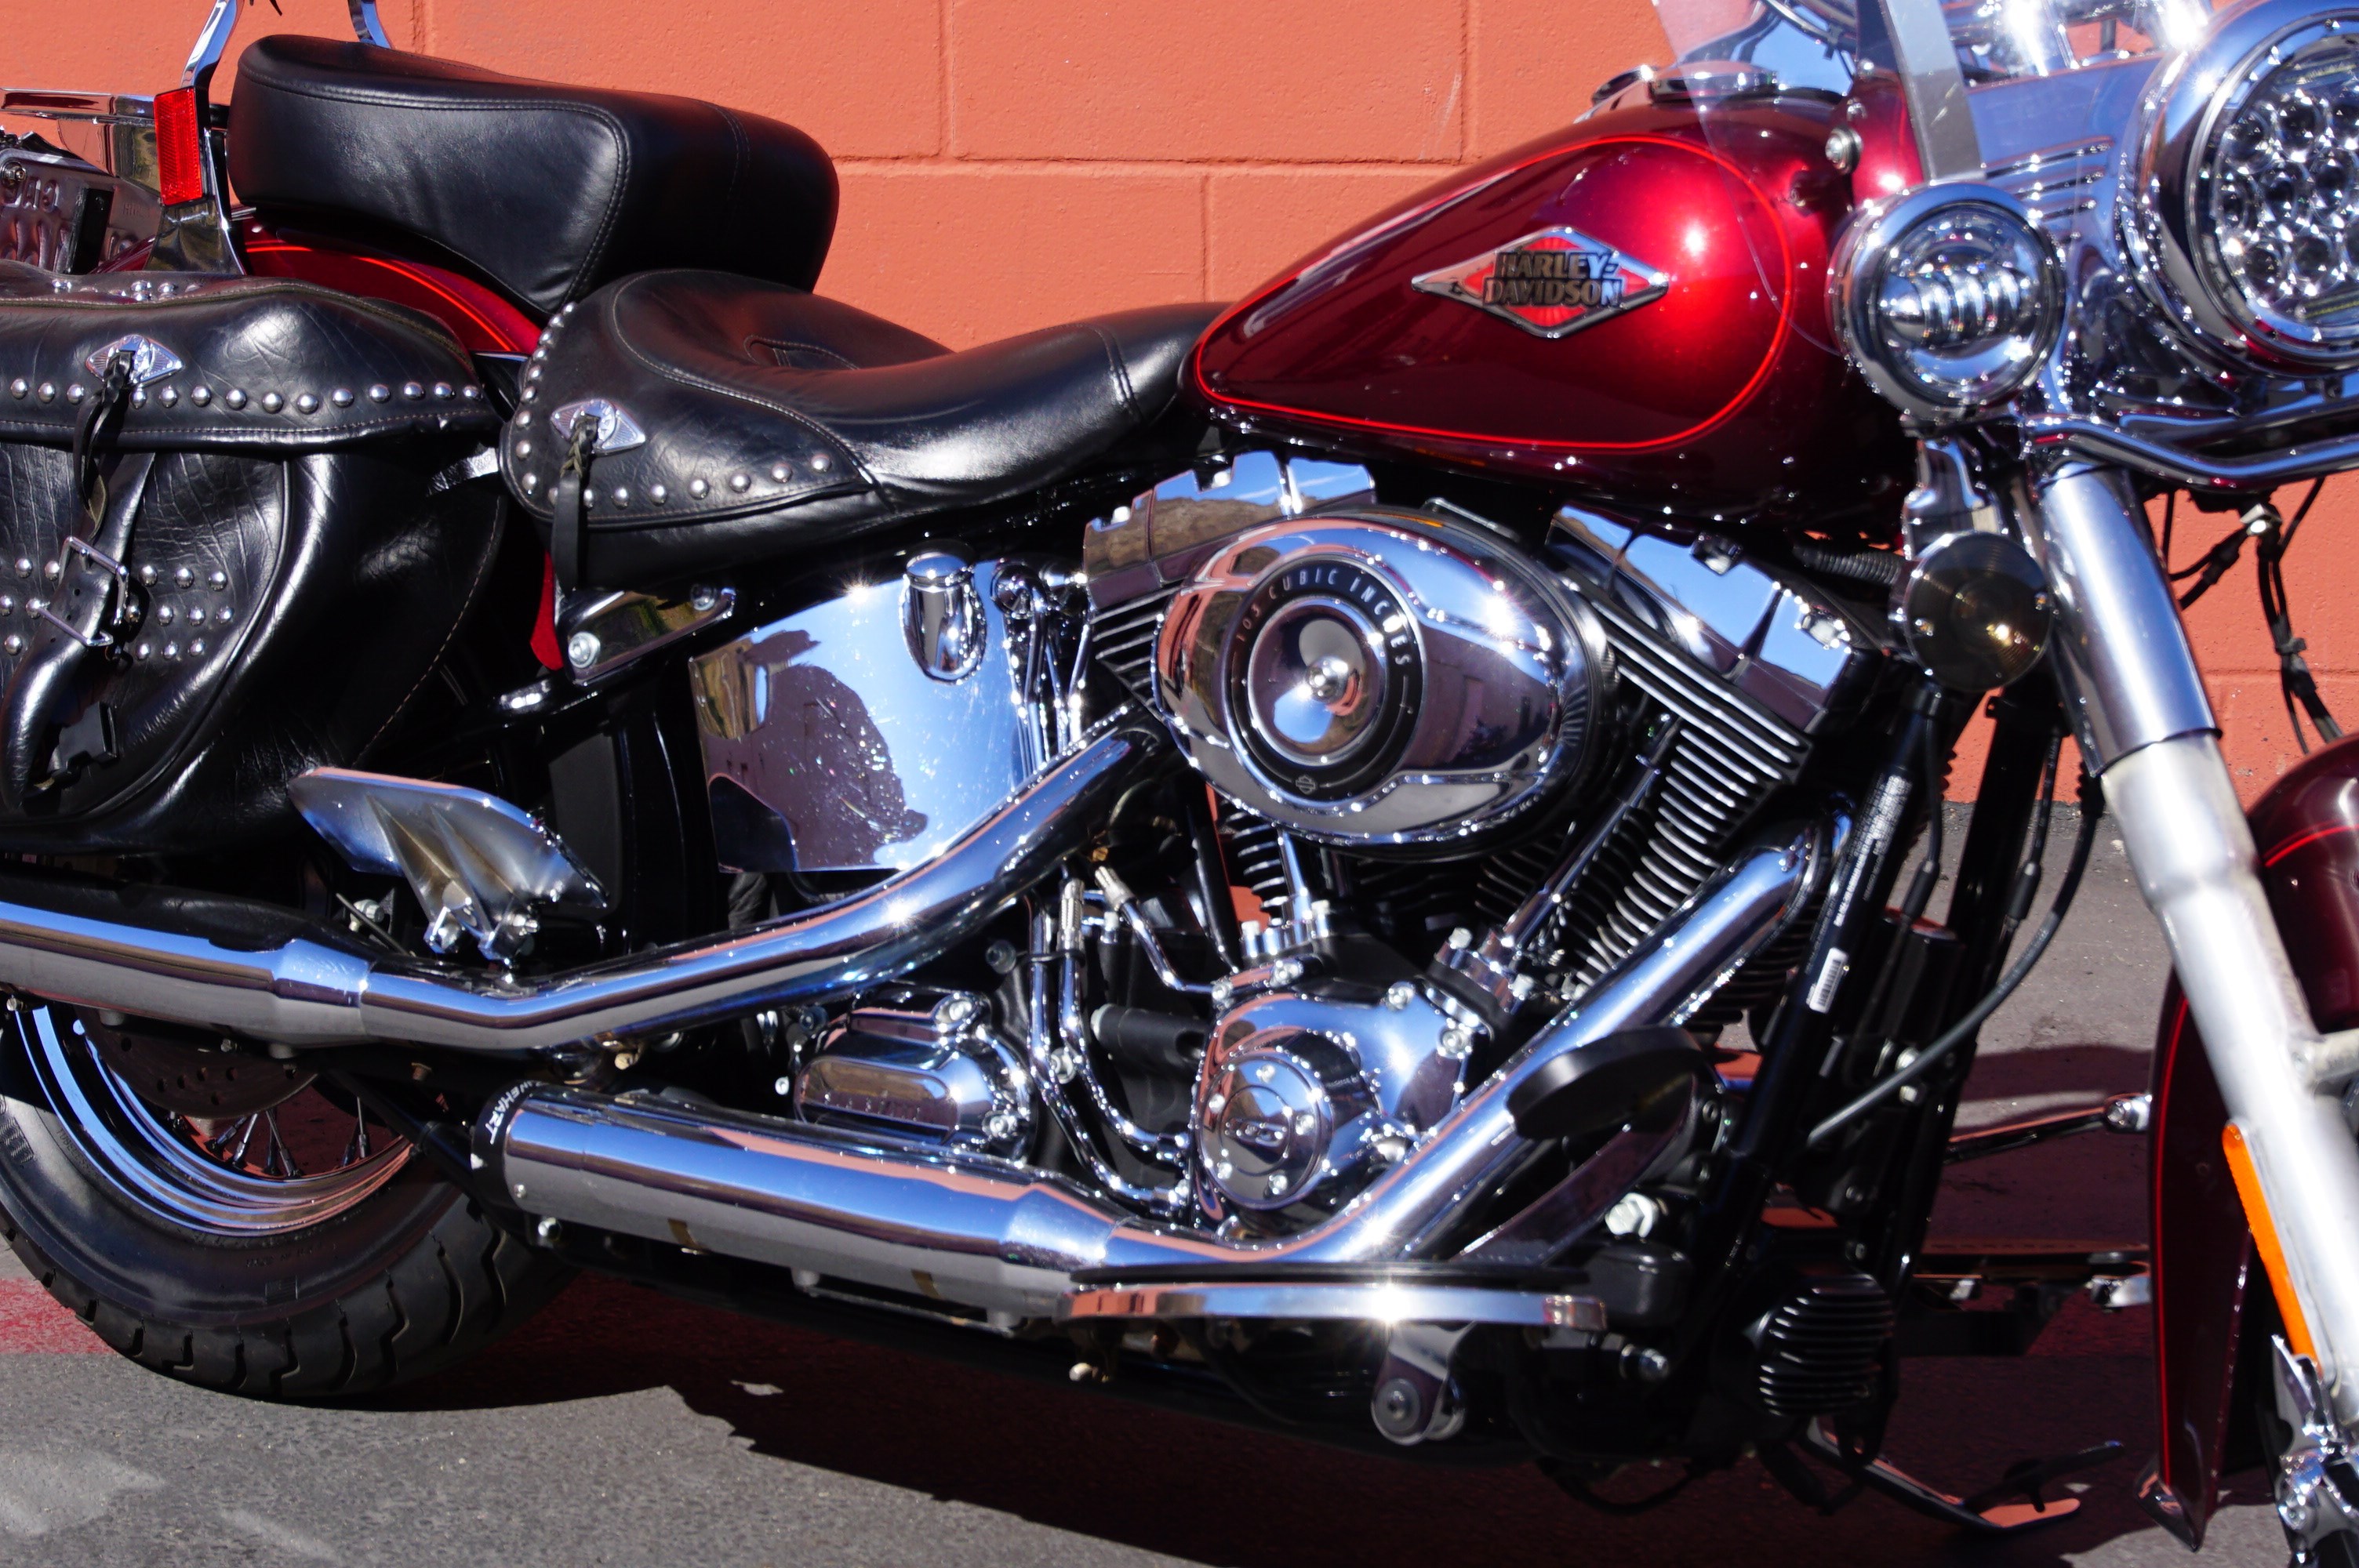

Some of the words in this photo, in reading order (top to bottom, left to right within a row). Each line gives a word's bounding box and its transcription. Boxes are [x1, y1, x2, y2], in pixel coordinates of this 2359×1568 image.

[1495, 251, 1619, 279] HARLEY-
[1482, 278, 1623, 307] DAVIDSON
[1235, 604, 1262, 643] 103
[1267, 567, 1339, 601] CUBIC
